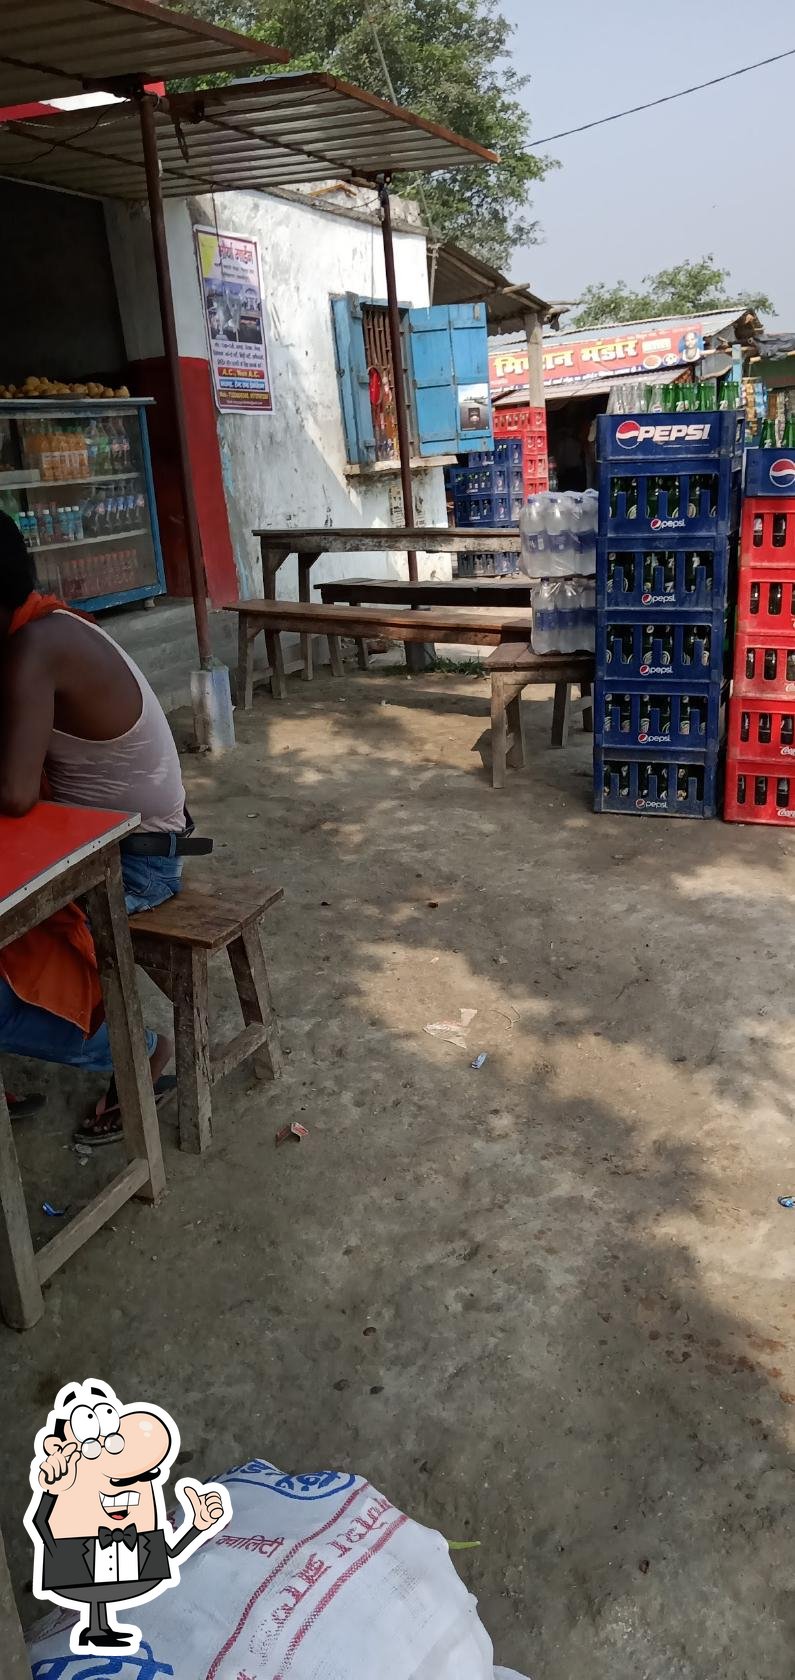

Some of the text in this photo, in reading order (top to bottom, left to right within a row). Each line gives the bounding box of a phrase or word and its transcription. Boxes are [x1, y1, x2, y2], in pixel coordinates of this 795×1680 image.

[581, 338, 638, 363] भंडार
[637, 424, 711, 442] PEPSI
[660, 518, 686, 529] pepsi
[651, 593, 676, 603] pepsi
[649, 665, 673, 675] pepsi
[647, 734, 671, 743] pepsi
[645, 799, 668, 809] pepsi
[215, 1534, 285, 1558] क्वालिटी
